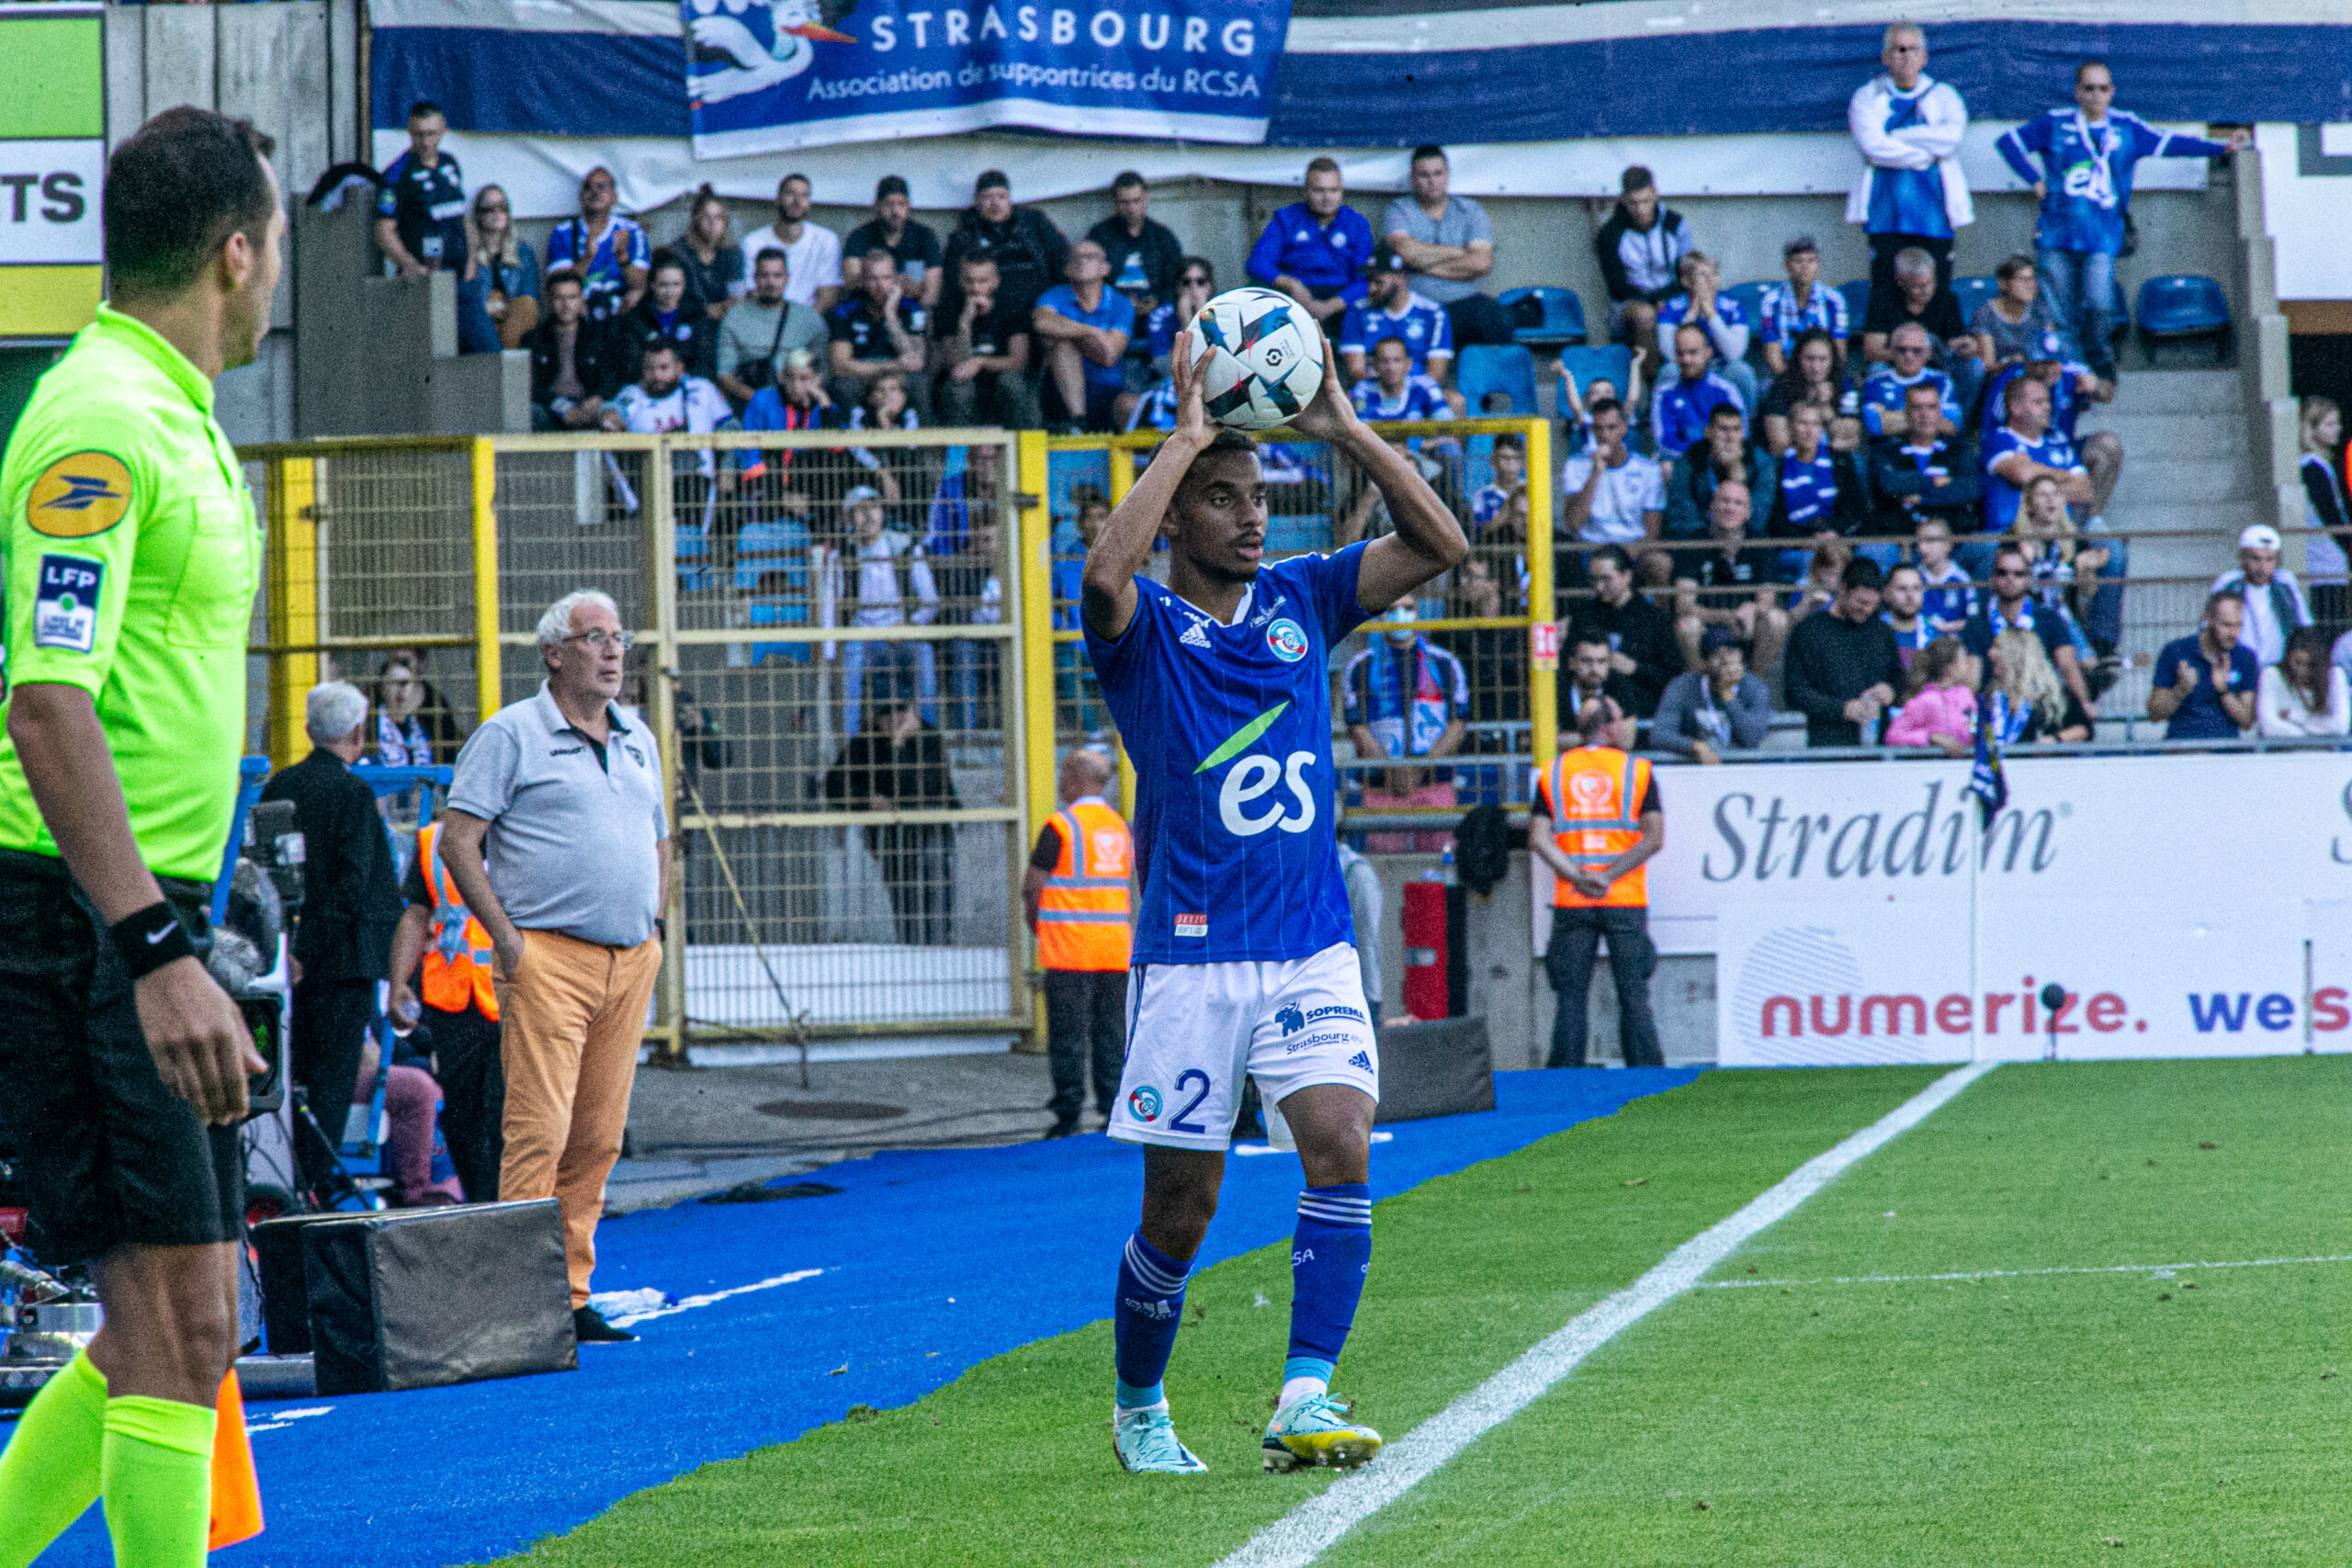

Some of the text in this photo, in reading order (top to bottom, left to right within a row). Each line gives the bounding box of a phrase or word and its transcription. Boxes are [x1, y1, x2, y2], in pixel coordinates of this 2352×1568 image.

[871, 4, 1256, 57] STRASBOURG
[806, 61, 1261, 103] Association de supportrices du RCSA
[47, 566, 96, 589] LFP
[1702, 779, 2058, 883] Stradim
[1306, 1005, 1366, 1021] SOPREMA
[1168, 1068, 1211, 1134] 2
[1292, 1248, 1315, 1270] SA
